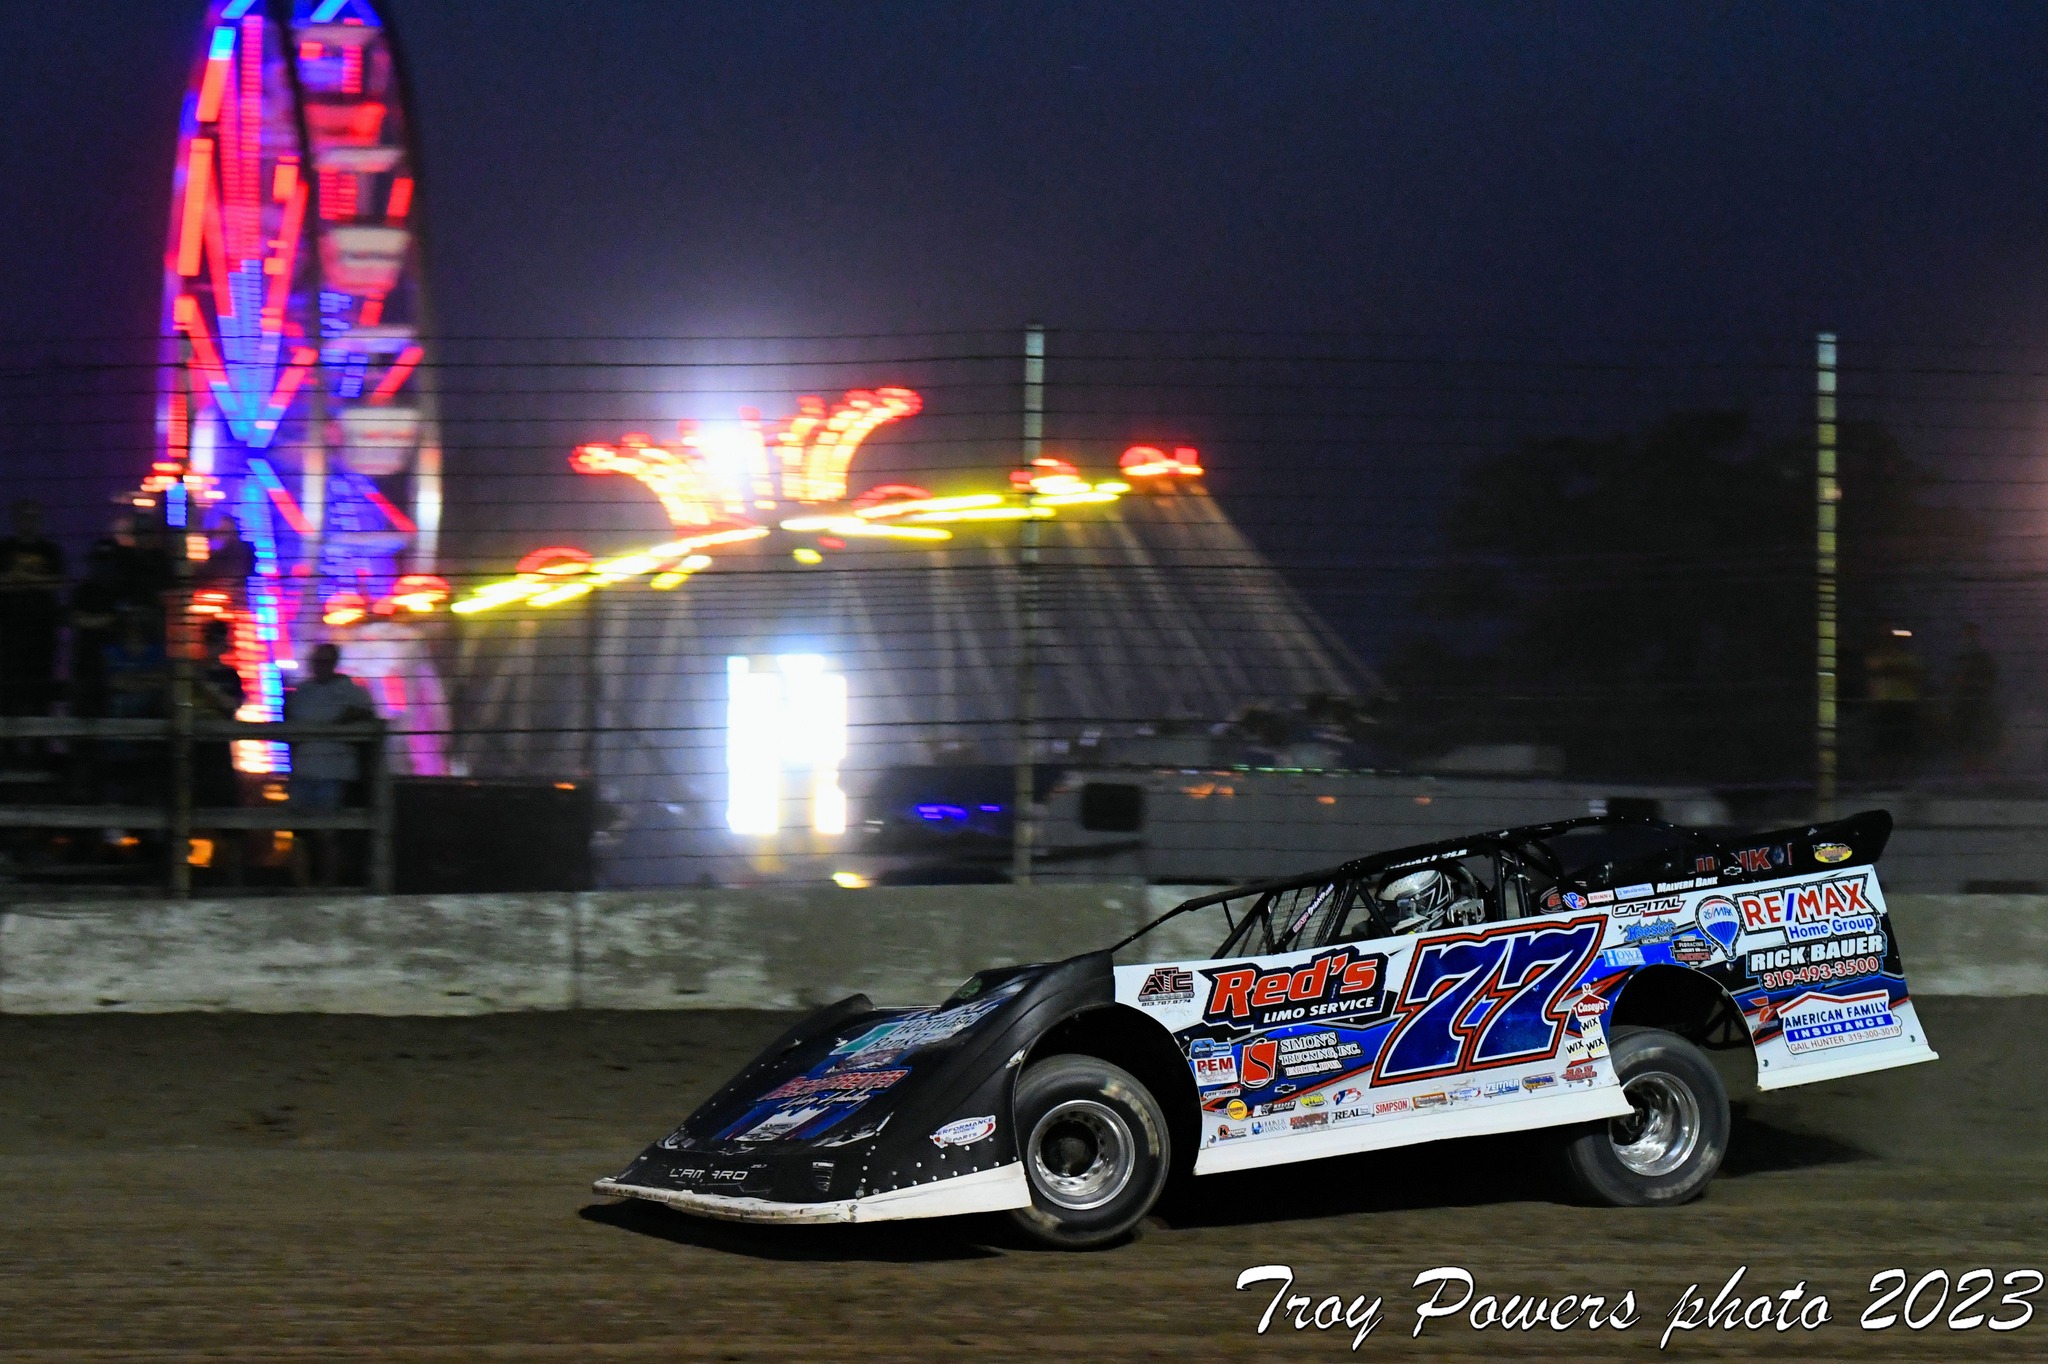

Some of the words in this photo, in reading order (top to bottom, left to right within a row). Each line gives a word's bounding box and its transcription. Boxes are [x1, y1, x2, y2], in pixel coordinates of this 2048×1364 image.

[1695, 876, 1718, 887] BANK
[1614, 899, 1679, 914] CAPITAL
[1742, 882, 1867, 927] RE/MAX
[1788, 923, 1829, 939] Home
[1832, 917, 1874, 932] Group
[1603, 950, 1643, 967] HOWE
[1751, 946, 1805, 972] RICK
[1810, 935, 1883, 959] BAUER
[1764, 956, 1879, 988] 319-493-3500
[1209, 953, 1378, 1018] Red's
[1263, 1005, 1305, 1024] LIMO
[1309, 997, 1375, 1017] SERVICE
[1371, 913, 1607, 1088] 77
[1577, 1001, 1605, 1014] Casey's
[1581, 1017, 1598, 1031] WIX
[1785, 1008, 1844, 1029] AMERICAN
[1849, 1001, 1887, 1018] FAMILY
[1794, 1016, 1886, 1040] INSURANCE
[1281, 1032, 1338, 1052] SIMON'S
[1566, 1039, 1584, 1054] WIX
[1586, 1037, 1604, 1052] WIX
[1790, 1041, 1809, 1051] GAIL
[1811, 1035, 1845, 1048] HUNTER
[1848, 1026, 1900, 1042] 319-300-3019
[1338, 1043, 1361, 1057] INC.
[1197, 1057, 1233, 1072] PEM
[1375, 1100, 1408, 1114] SIMPSON
